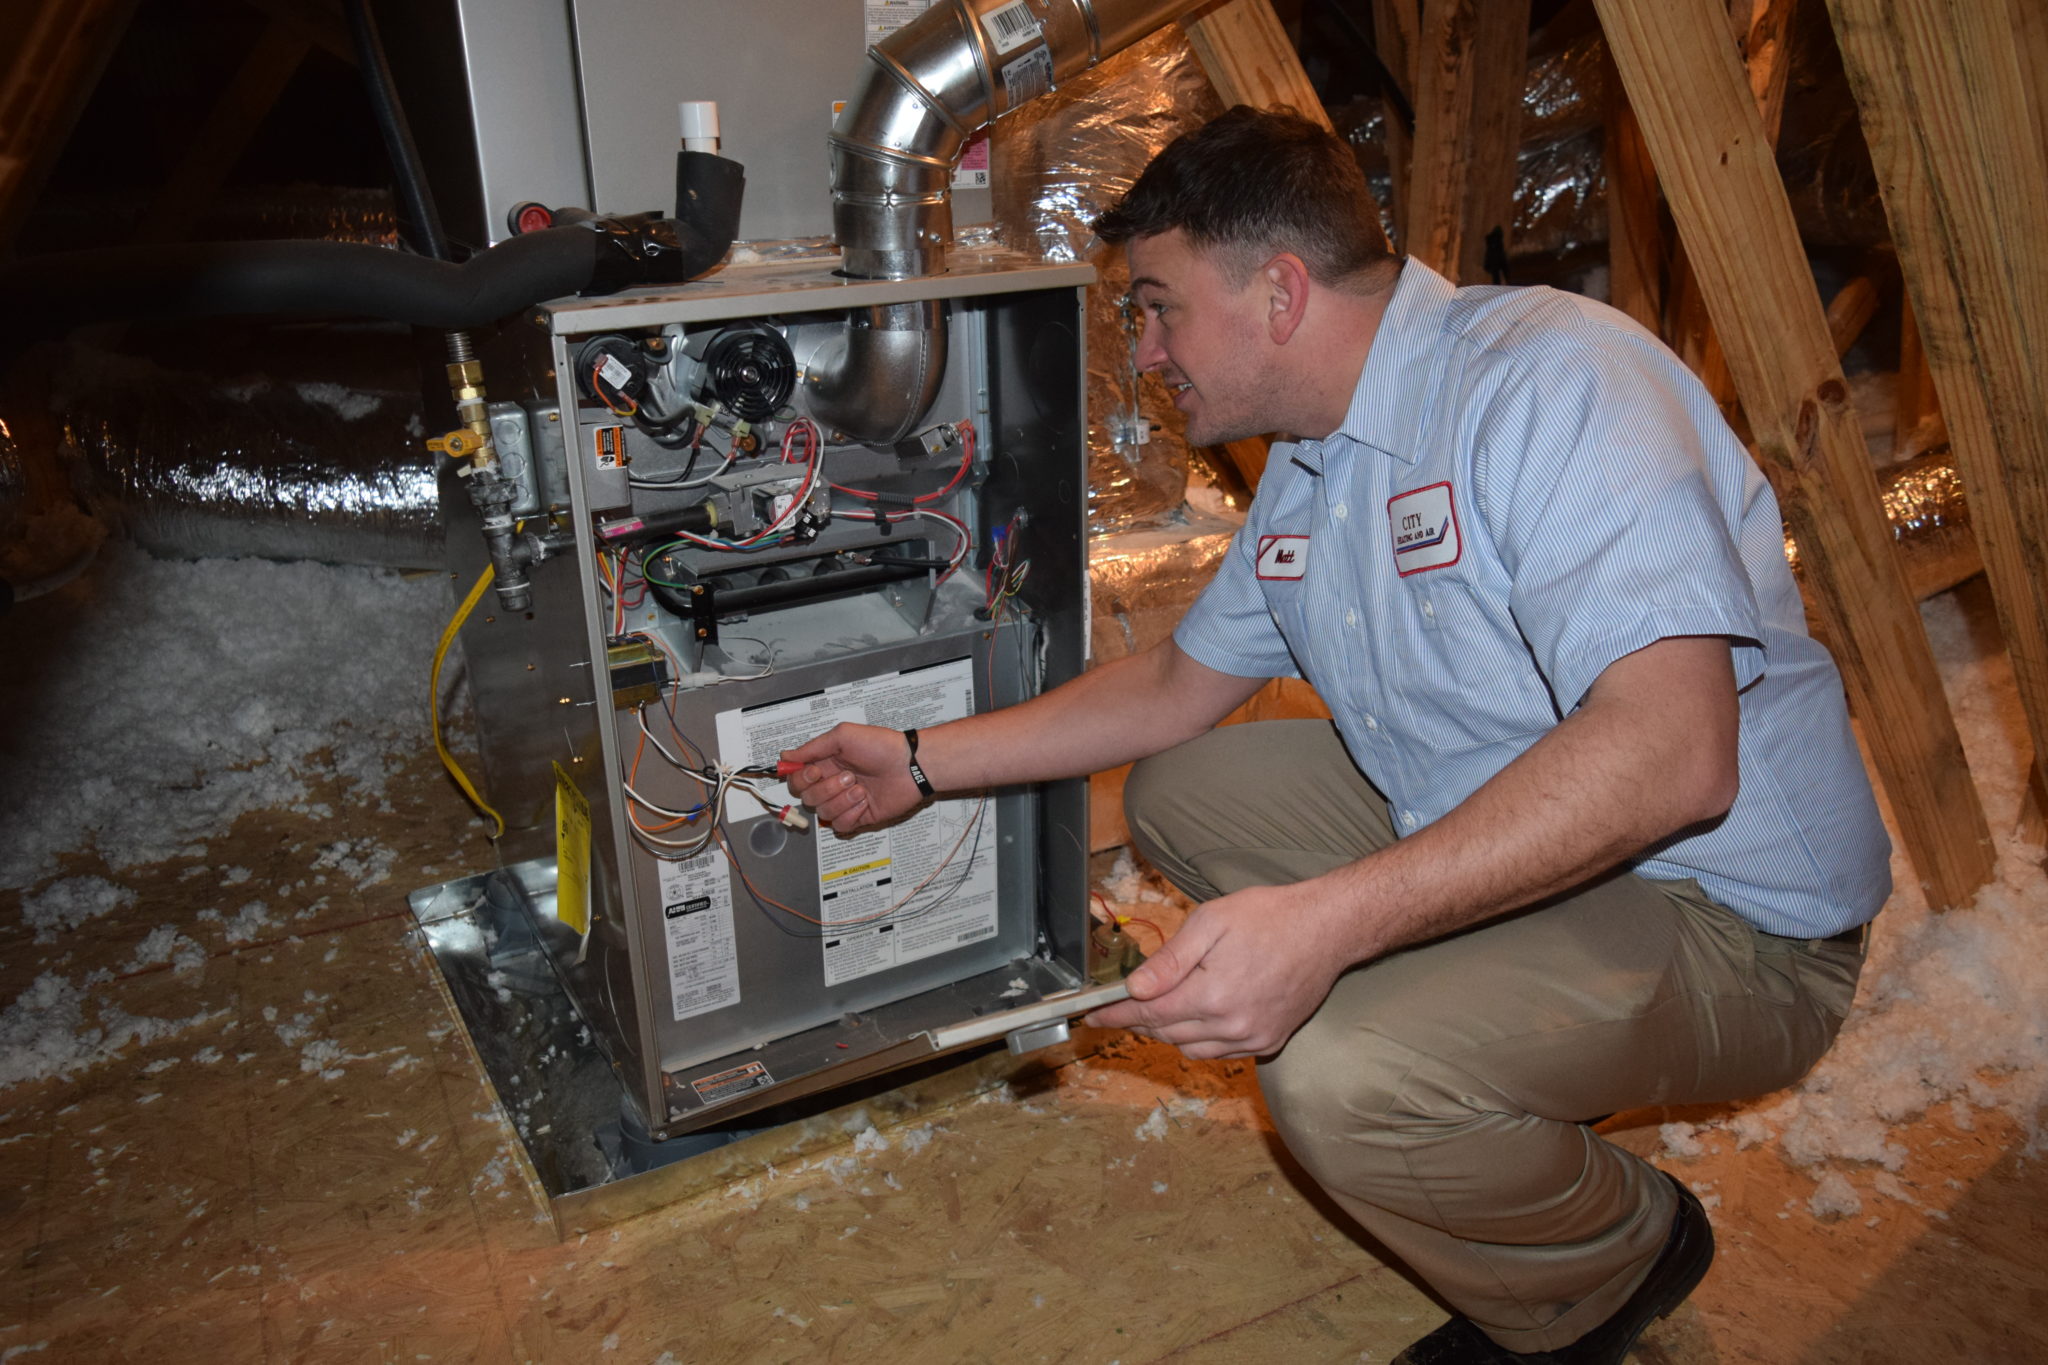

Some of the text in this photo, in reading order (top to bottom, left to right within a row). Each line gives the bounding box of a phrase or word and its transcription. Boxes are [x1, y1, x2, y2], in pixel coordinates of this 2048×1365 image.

[1402, 512, 1422, 531] CITY
[1414, 530, 1424, 540] AND
[1425, 527, 1436, 537] AIR
[1274, 549, 1295, 564] Matt
[848, 864, 871, 874] CAUTION
[840, 883, 874, 895] INSTALLATION
